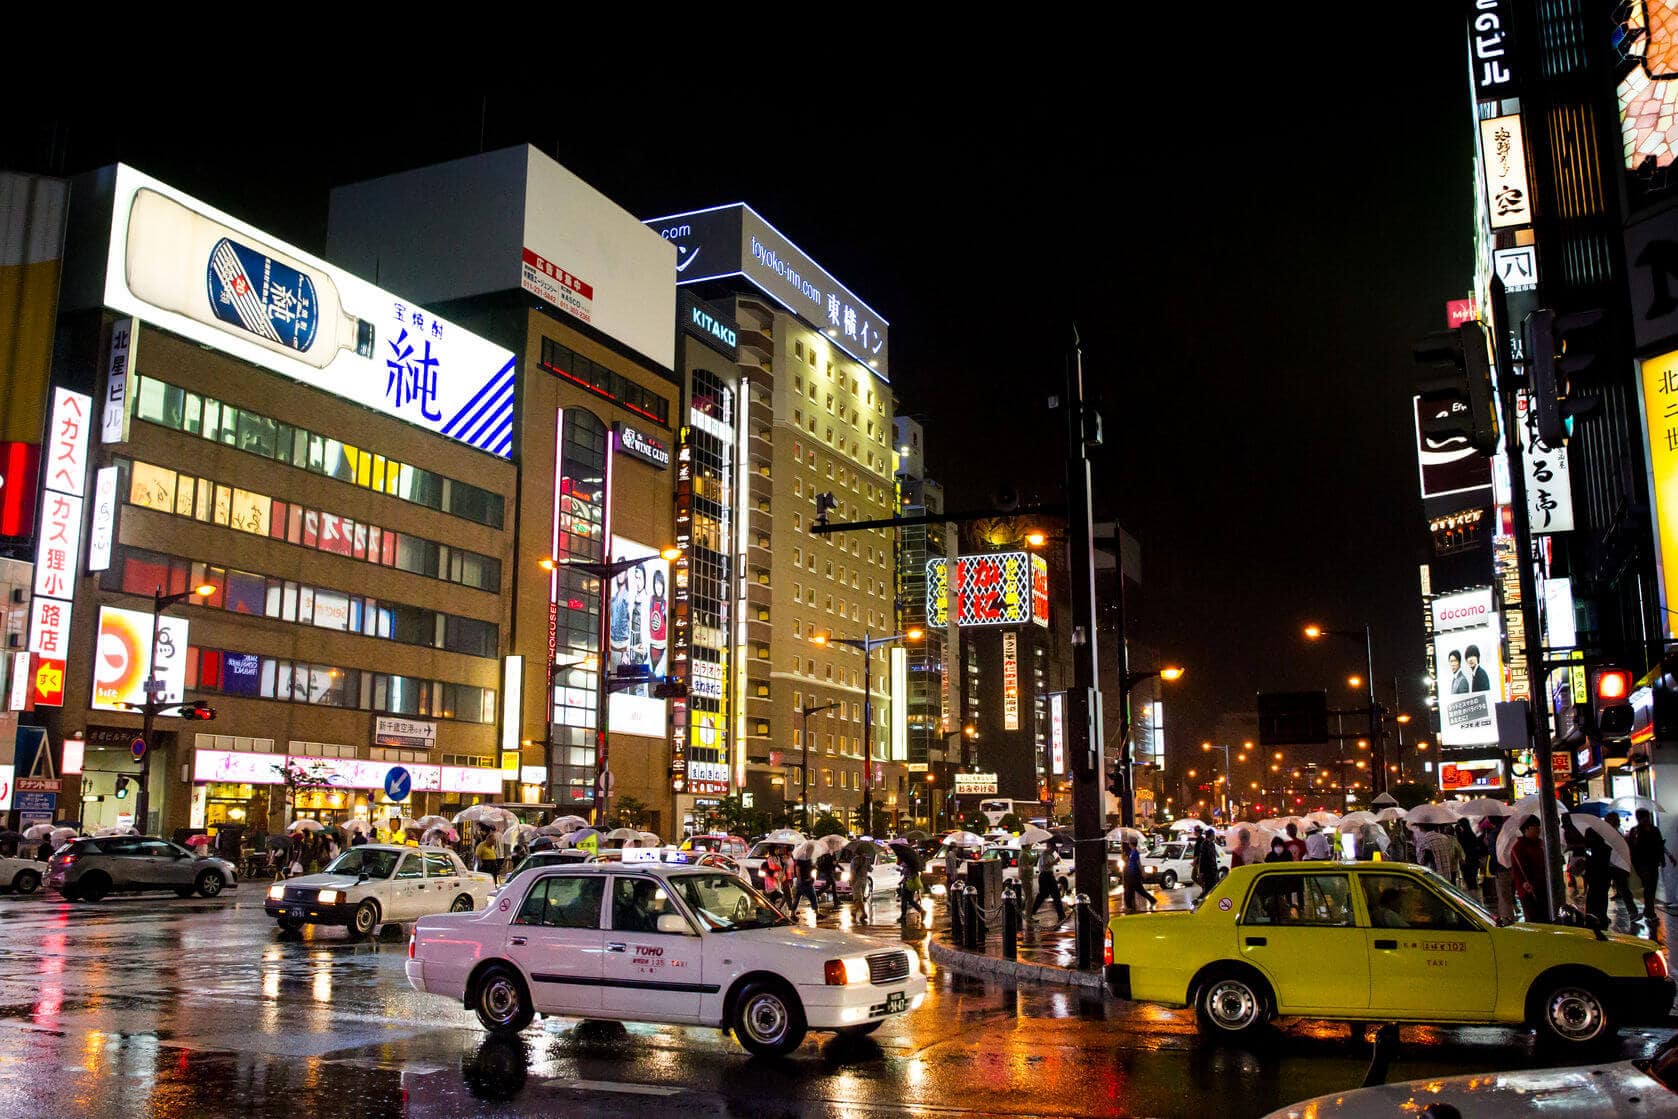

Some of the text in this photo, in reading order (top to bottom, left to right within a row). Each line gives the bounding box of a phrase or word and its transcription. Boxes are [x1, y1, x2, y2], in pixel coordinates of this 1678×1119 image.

[752, 235, 821, 305] toyoko-inn.com
[393, 302, 444, 342] 宝焼酎
[692, 306, 737, 348] KITAKO
[826, 293, 883, 354] 東横イン
[105, 324, 130, 429] 北星ビル
[386, 327, 443, 424] 純
[634, 440, 652, 457] WINE
[652, 448, 669, 464] CLUB
[548, 603, 558, 658] HOKUSEI
[1440, 604, 1486, 621] docomo
[693, 661, 722, 679] カラオケ
